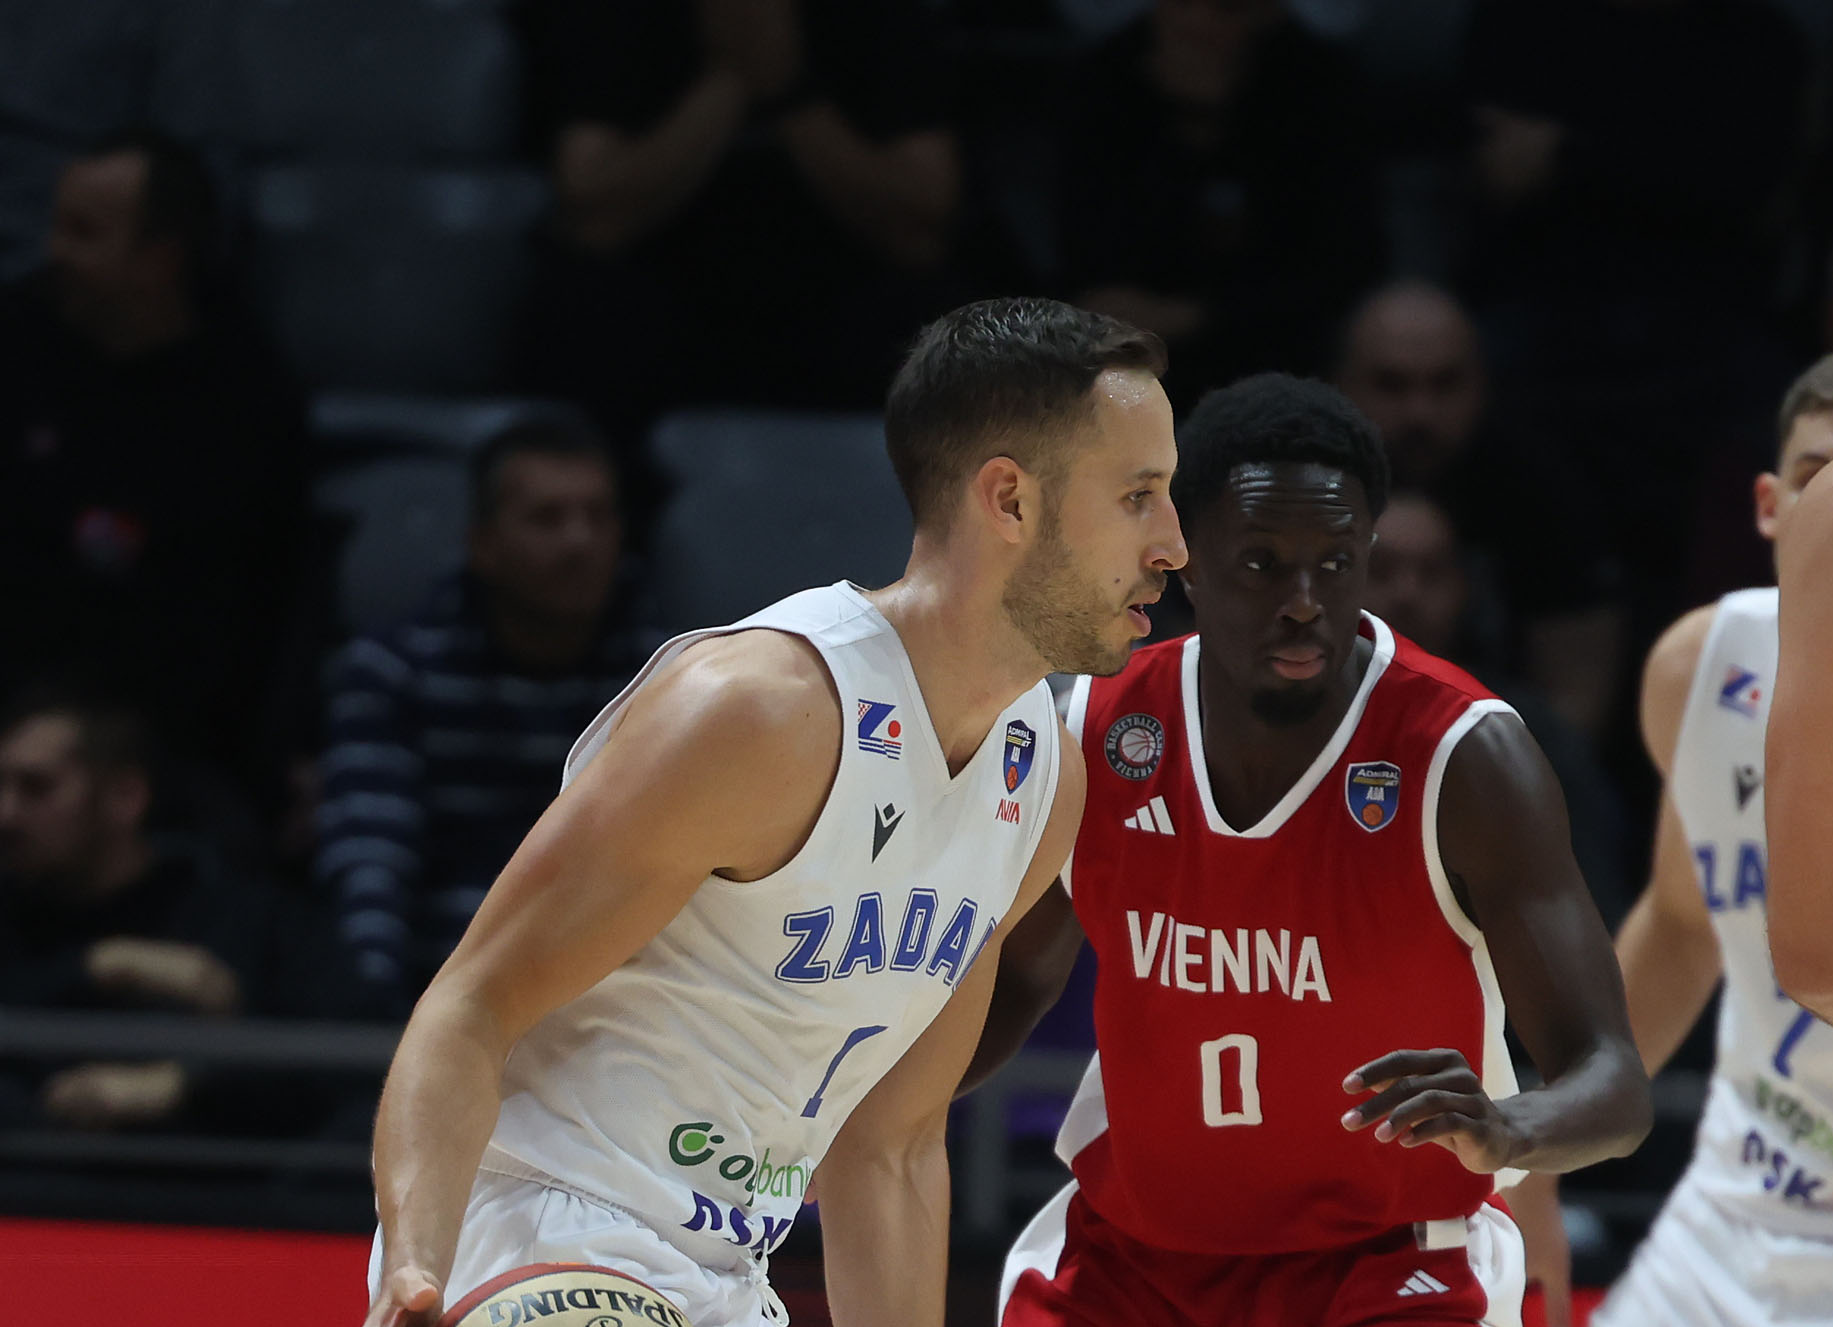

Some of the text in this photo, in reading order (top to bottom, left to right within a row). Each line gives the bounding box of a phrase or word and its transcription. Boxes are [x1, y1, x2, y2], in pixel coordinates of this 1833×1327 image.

[1356, 768, 1399, 780] ADMIRAL
[1127, 910, 1332, 1003] VIENNA
[1201, 1033, 1263, 1128] 0
